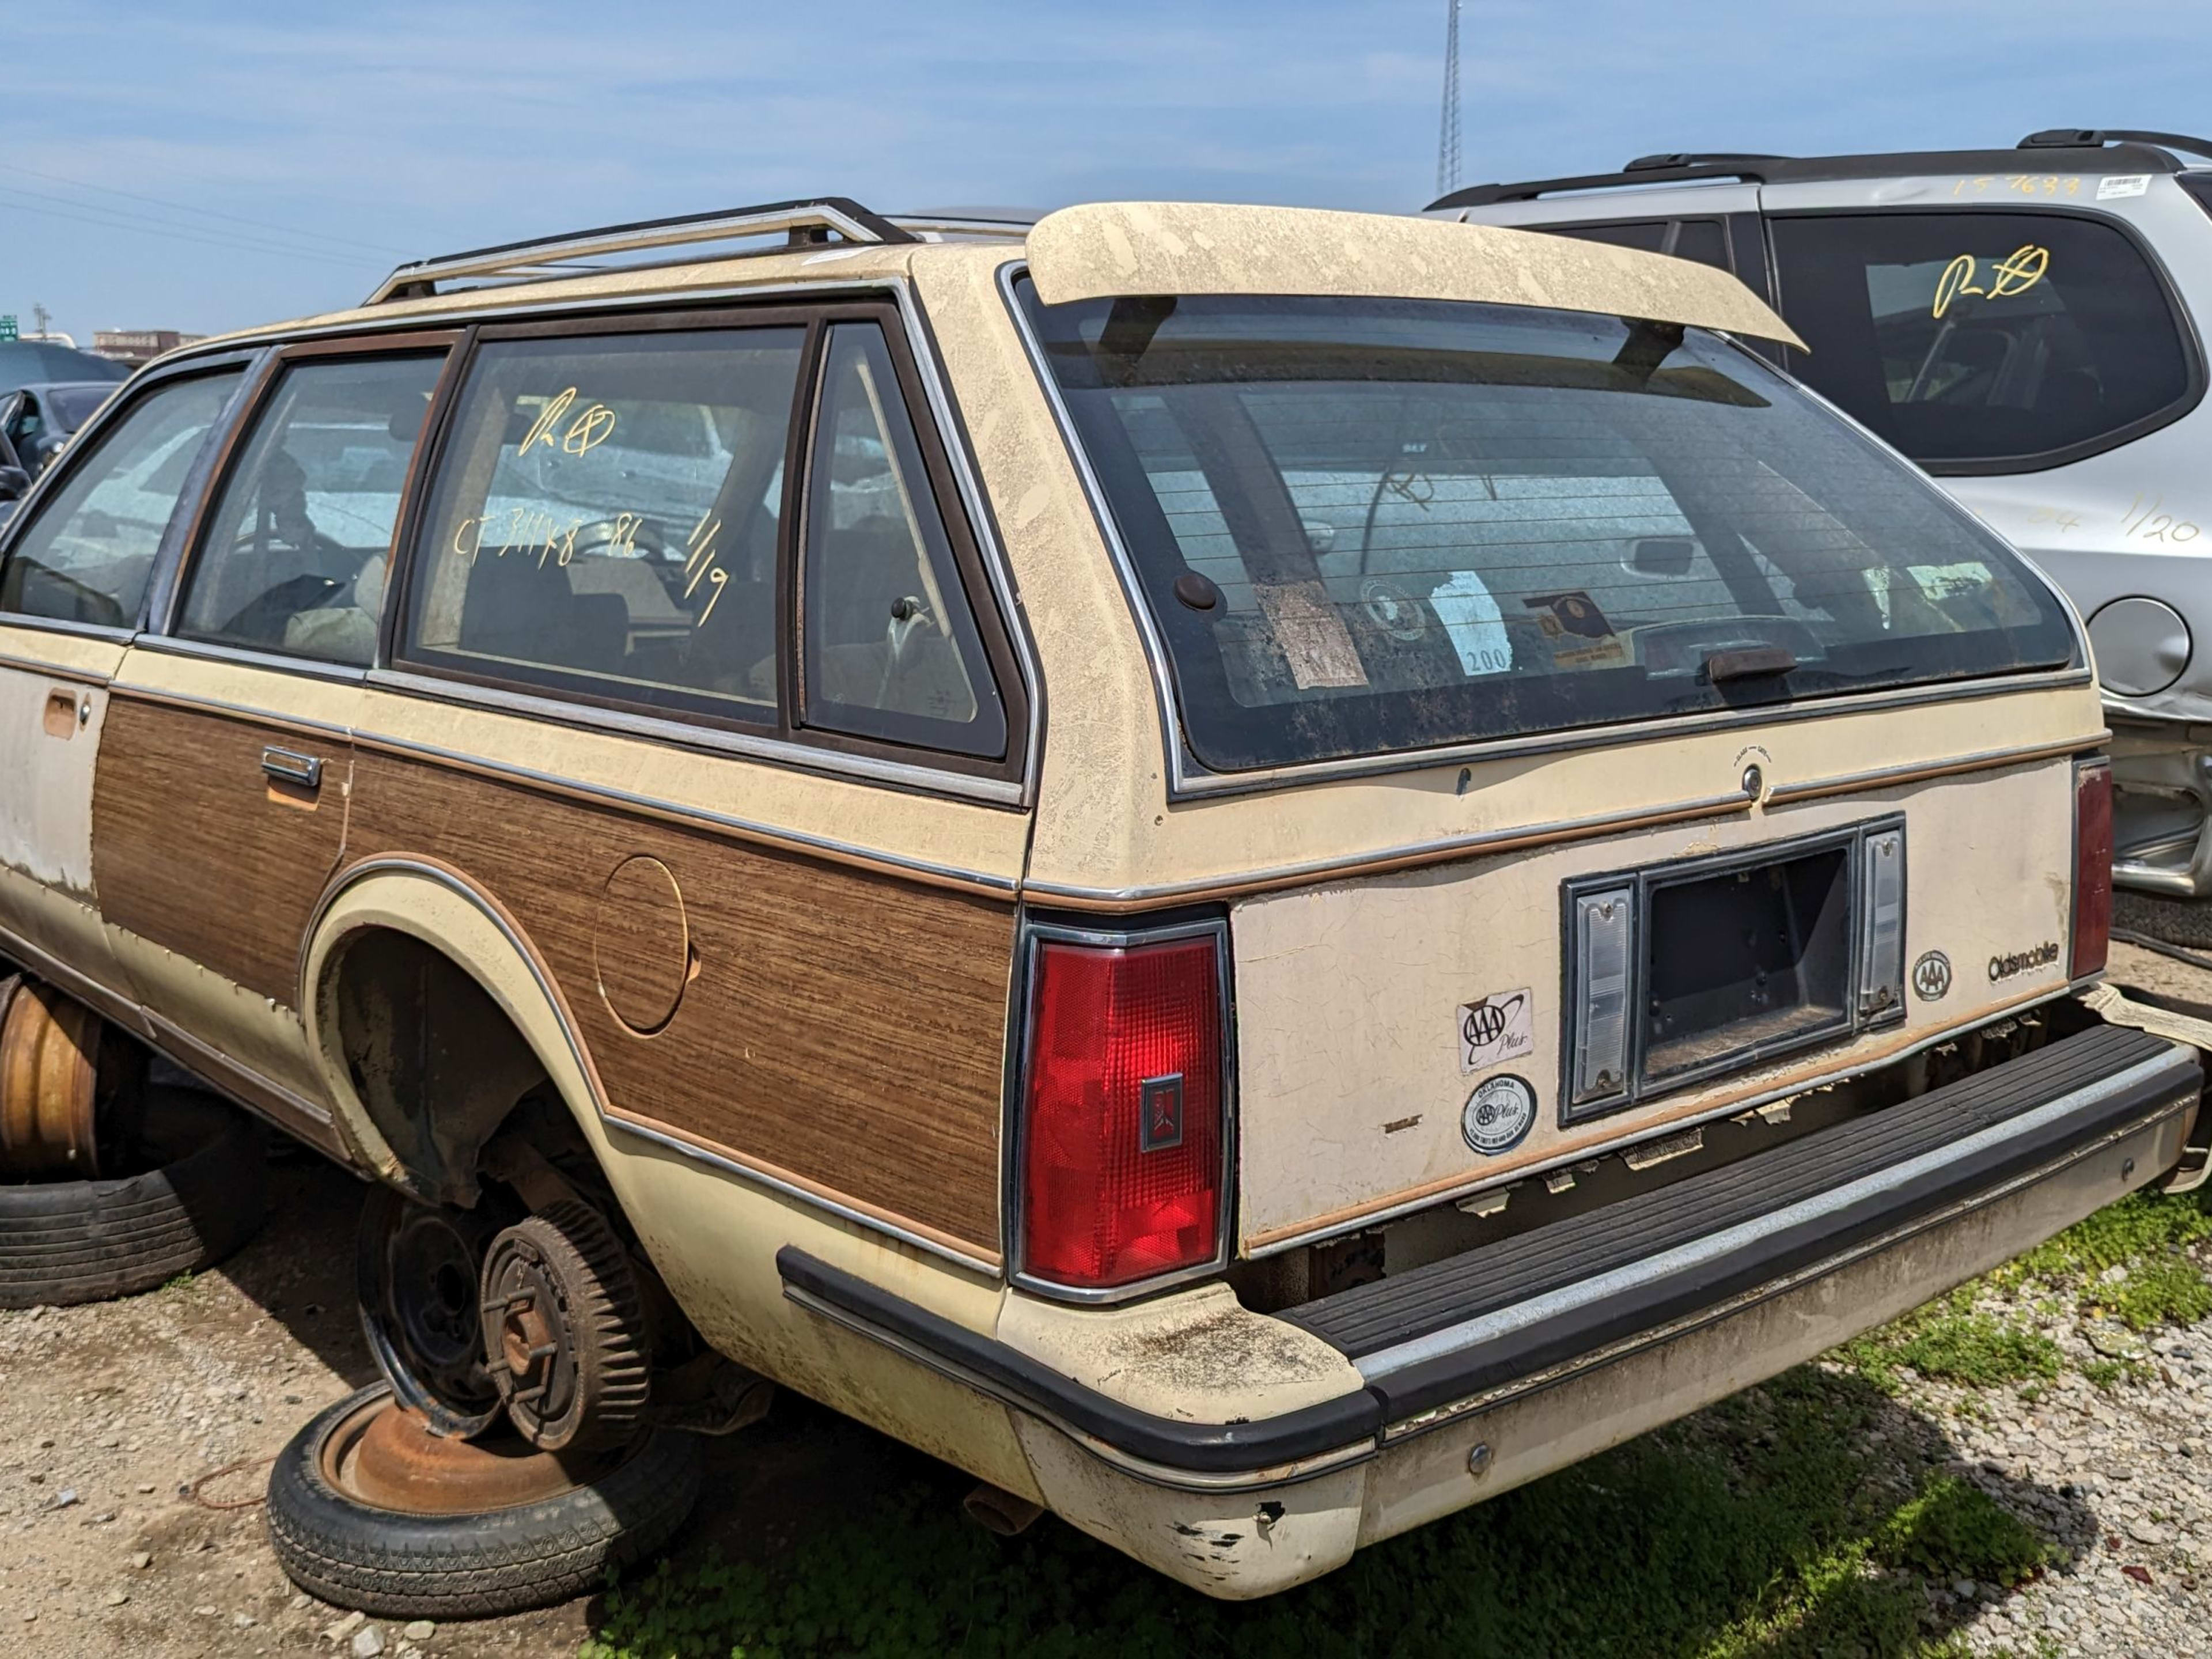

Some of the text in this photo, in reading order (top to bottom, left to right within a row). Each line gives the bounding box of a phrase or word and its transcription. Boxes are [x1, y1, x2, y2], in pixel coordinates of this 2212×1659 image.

[1919, 960, 1945, 991] AAA
[1988, 941, 2058, 981] Oldsmobile
[1467, 1007, 1502, 1045] AAA
[1478, 1080, 1515, 1099] OKLAHOMA
